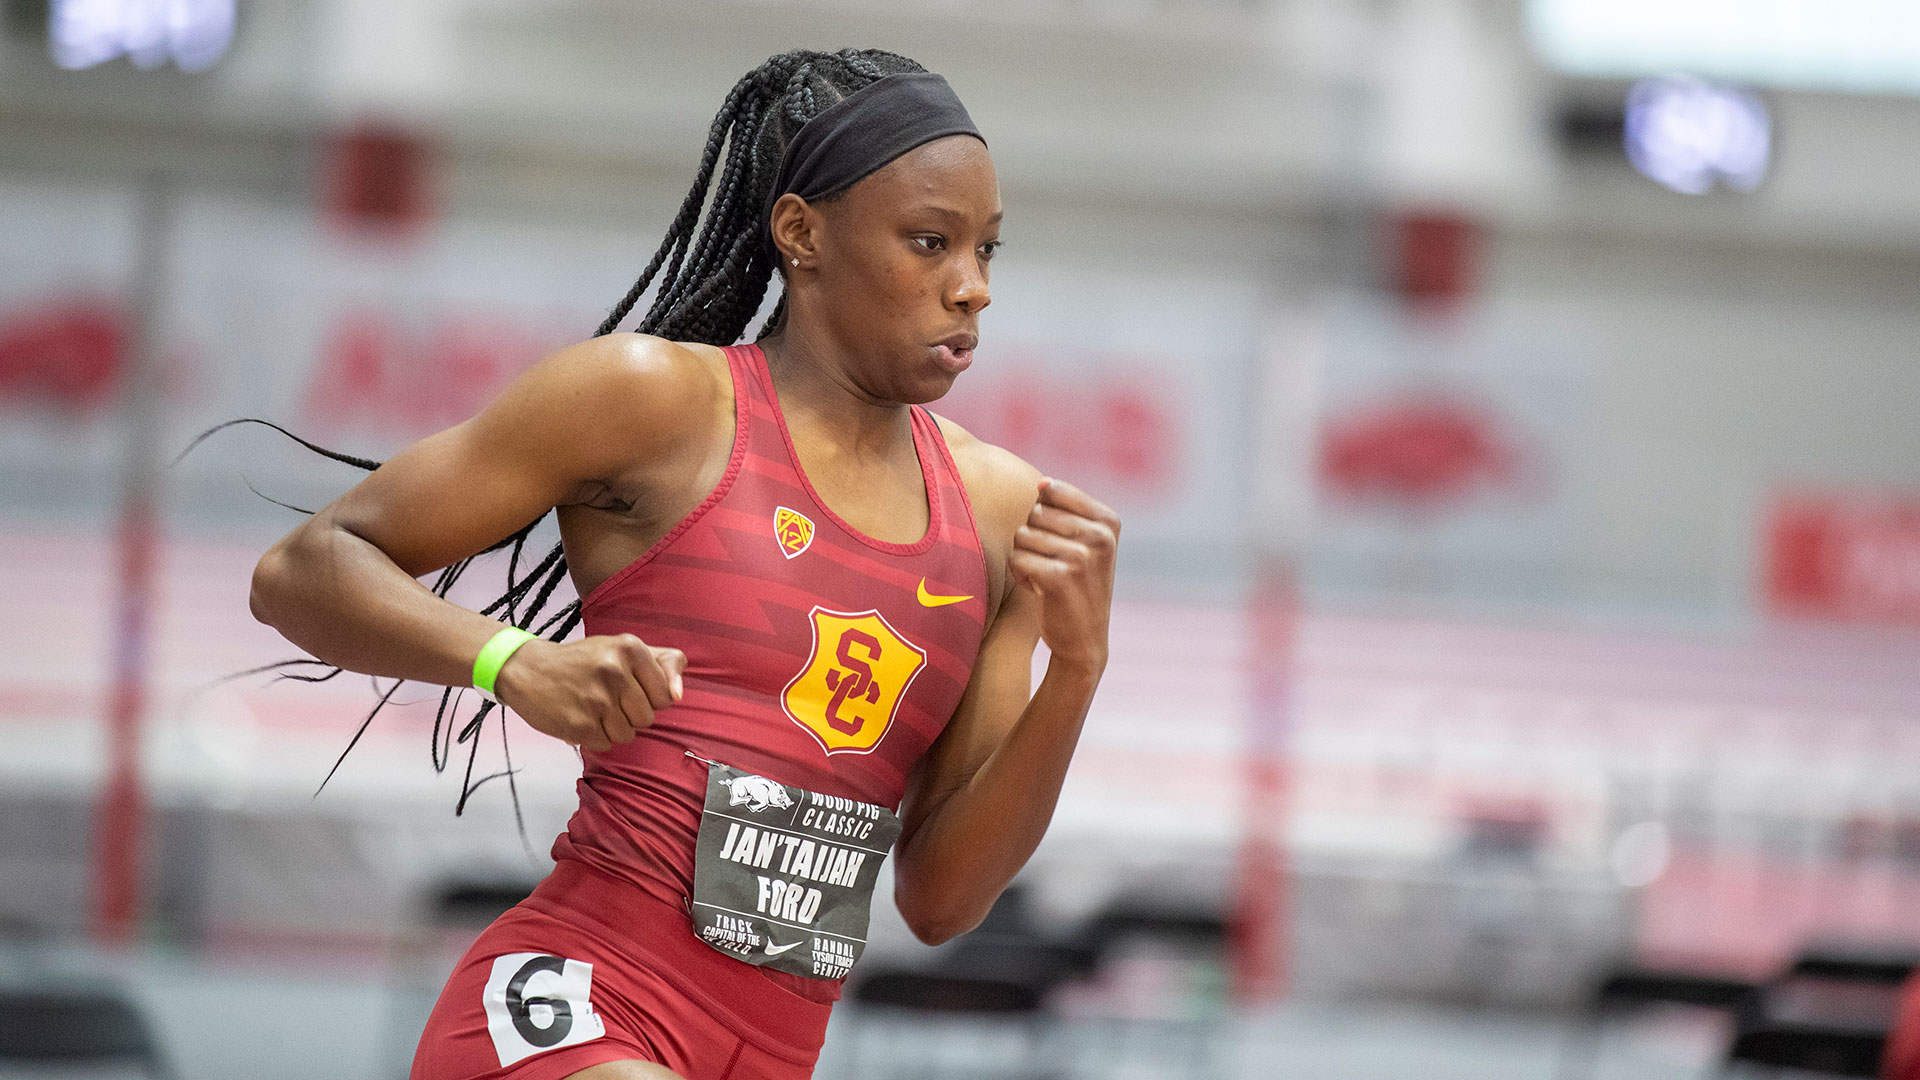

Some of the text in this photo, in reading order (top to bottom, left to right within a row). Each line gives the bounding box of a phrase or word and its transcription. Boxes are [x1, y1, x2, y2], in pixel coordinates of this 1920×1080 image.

[777, 509, 812, 545] PAC
[782, 529, 801, 551] 12
[857, 801, 880, 820] PIG
[802, 808, 873, 839] CLASSIC
[719, 822, 866, 888] JAN'TAIJAH
[757, 875, 822, 925] FORD
[715, 914, 753, 934] TRACK
[703, 925, 760, 946] CAPITAL OF THE
[811, 950, 835, 965] TYSON
[813, 937, 854, 958] RANDAL
[506, 956, 573, 1048] 6
